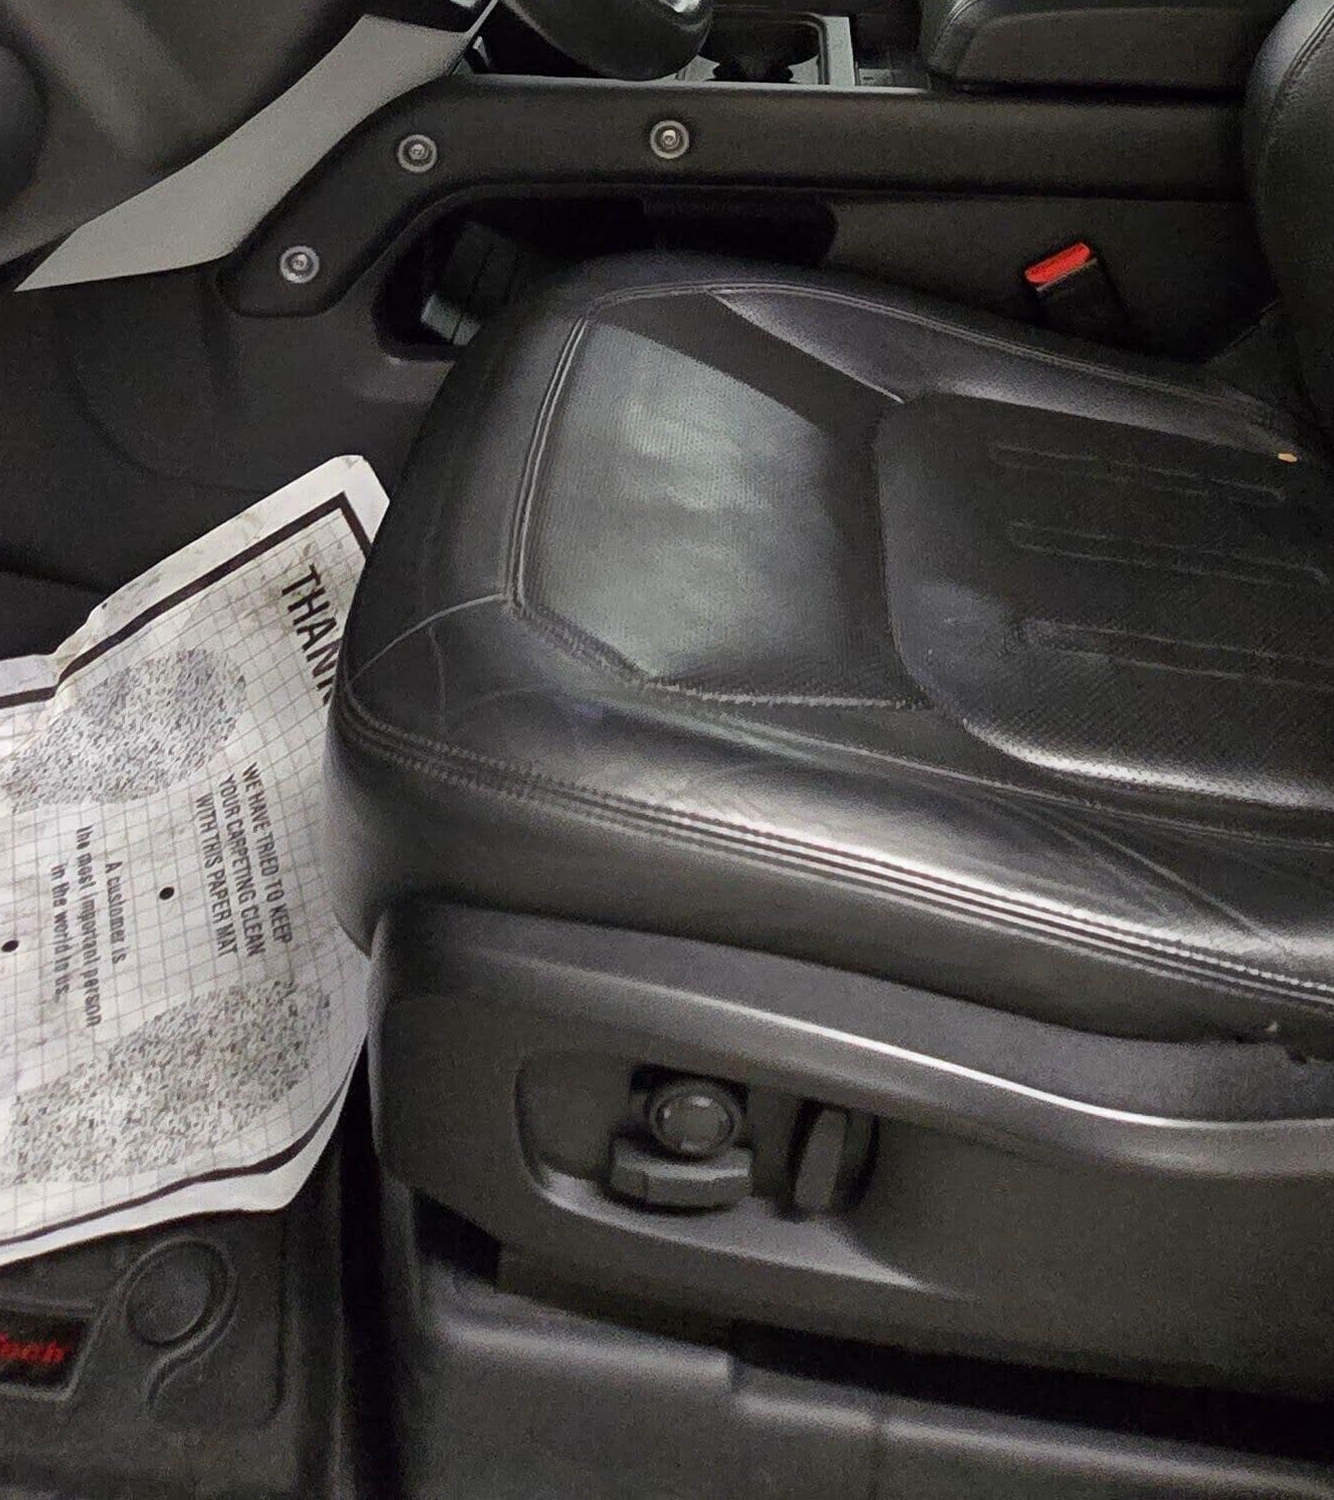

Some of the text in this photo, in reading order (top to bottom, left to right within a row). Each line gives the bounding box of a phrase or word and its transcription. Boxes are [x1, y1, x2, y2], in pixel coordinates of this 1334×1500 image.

[51, 864, 66, 881] in
[52, 881, 71, 908] the
[196, 792, 238, 957] WITH THIS PAPER MAT
[219, 773, 267, 957] YOUR CARPETING CLEAN
[243, 761, 293, 944] WE HAVE TRIED TO KEEP
[53, 911, 75, 954] world
[54, 955, 71, 973] to
[76, 824, 102, 1028] the most important person
[105, 861, 131, 964] A customer is
